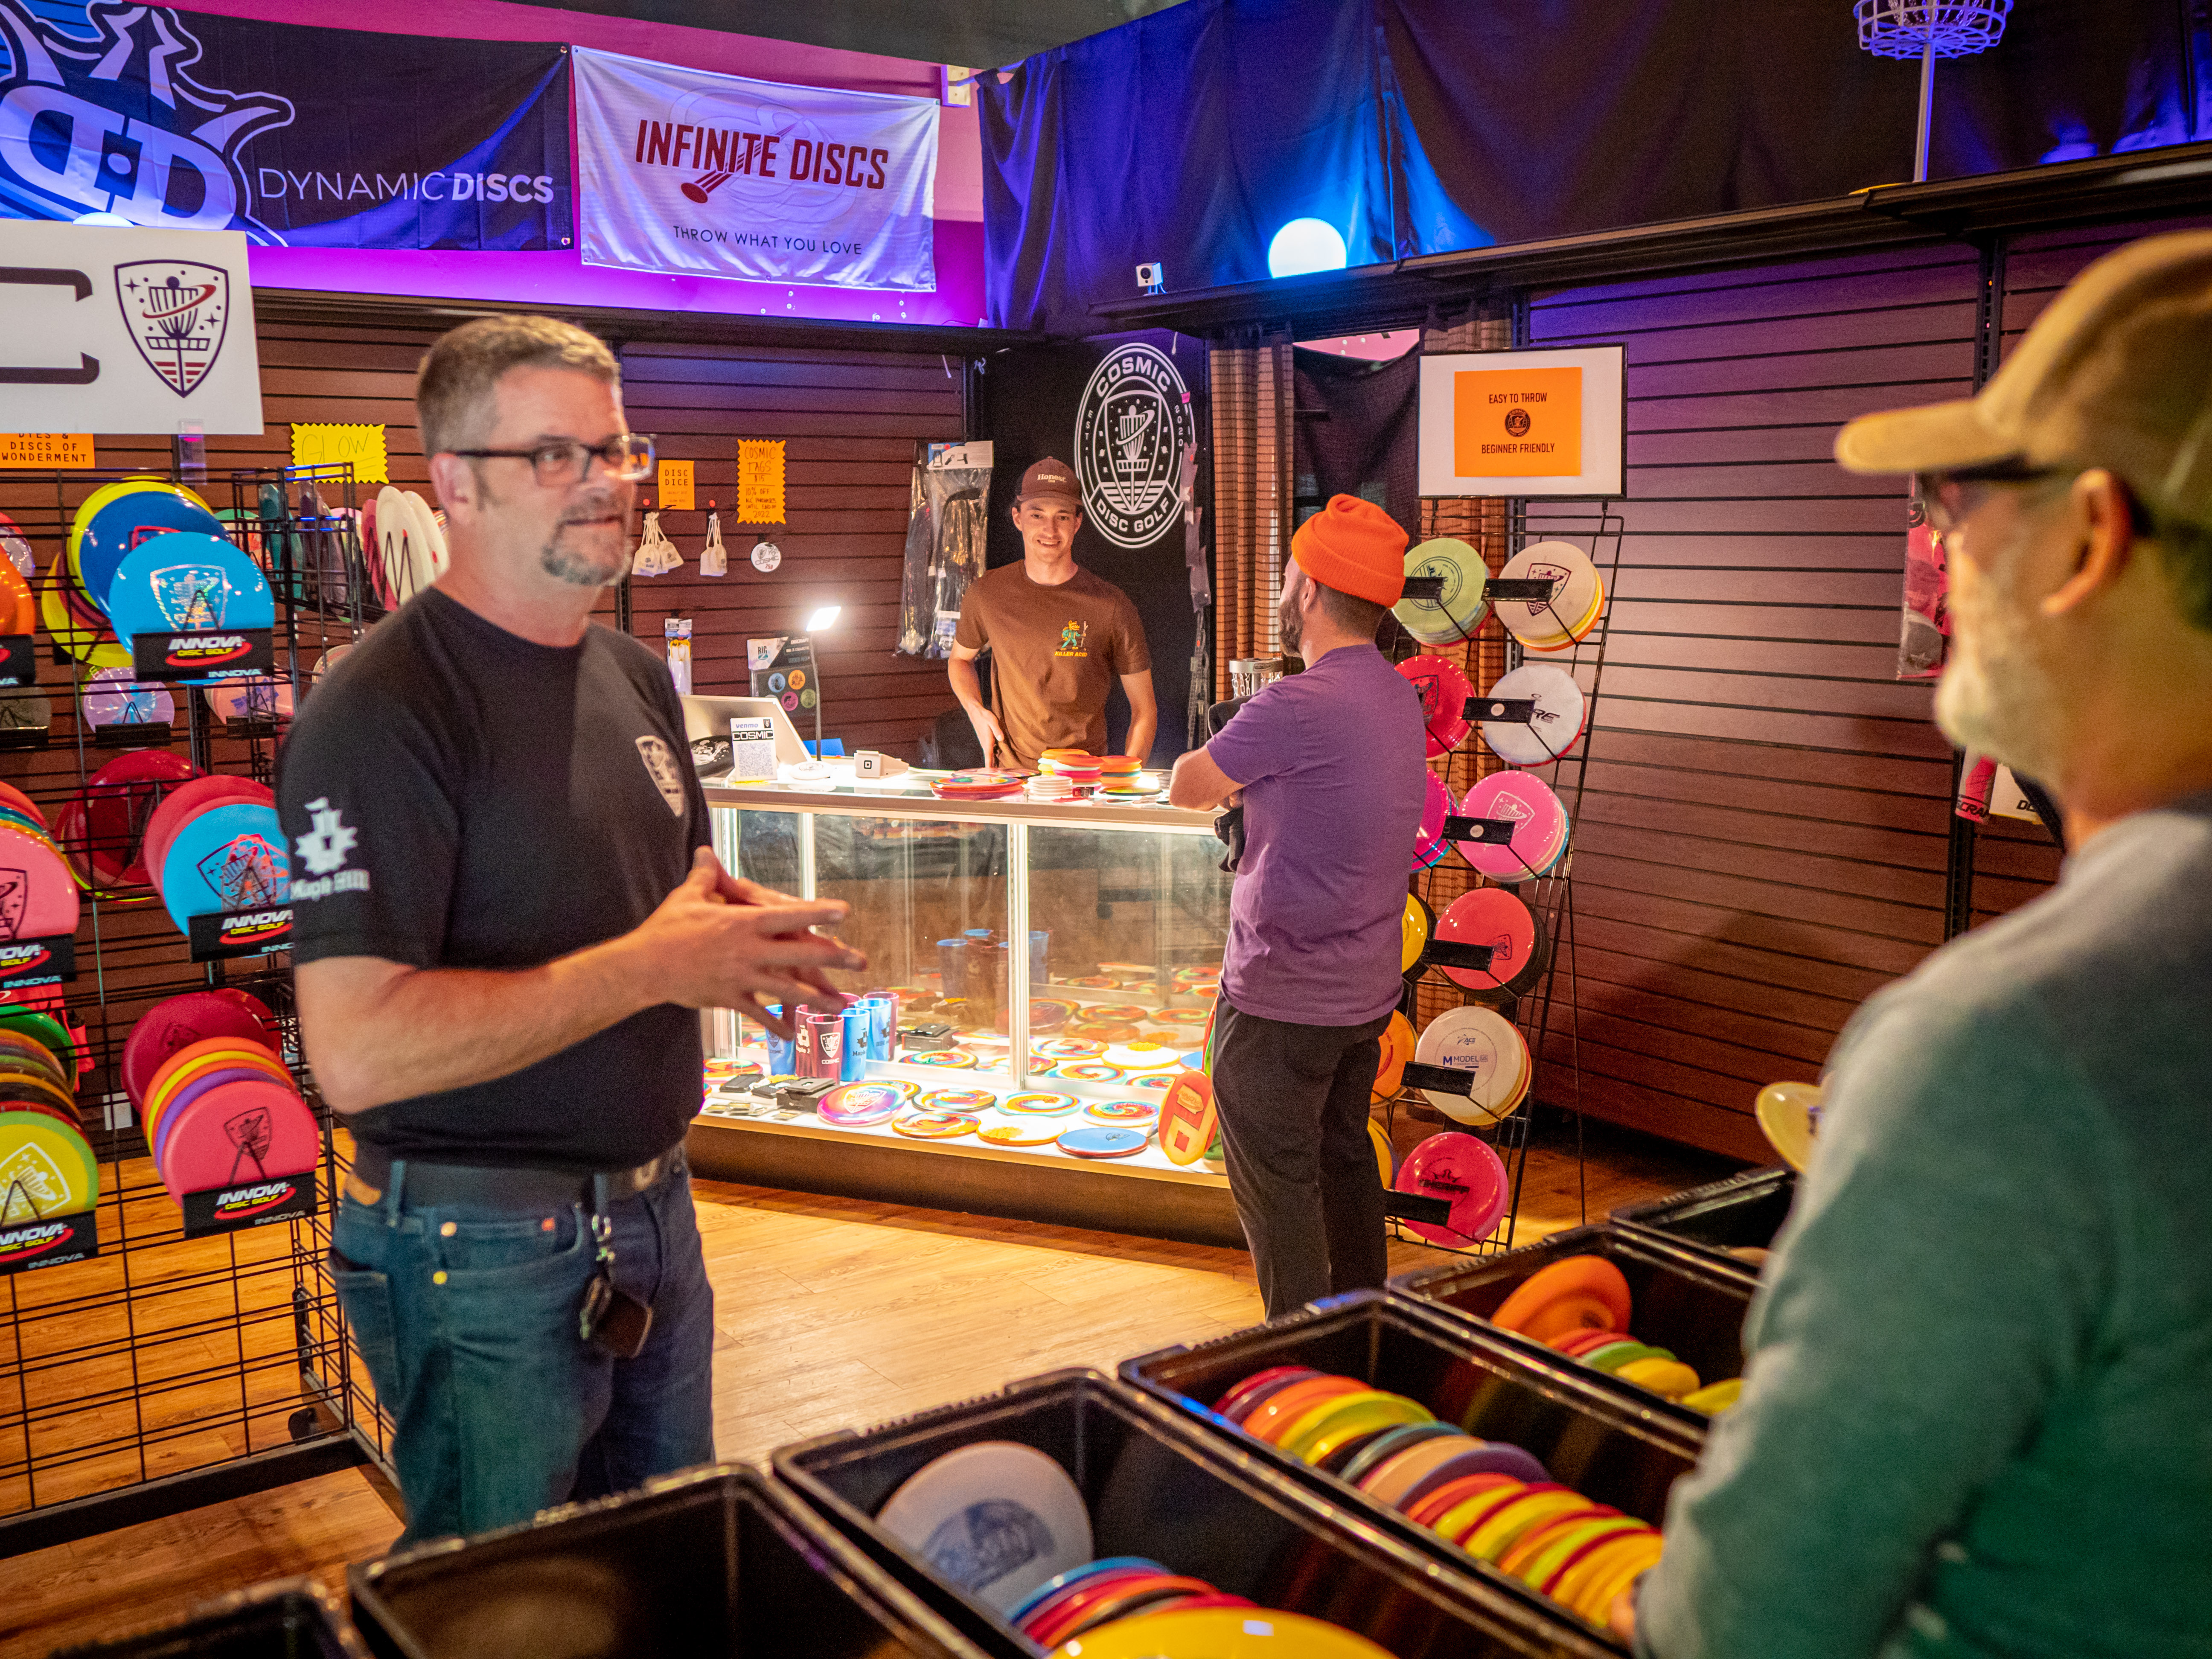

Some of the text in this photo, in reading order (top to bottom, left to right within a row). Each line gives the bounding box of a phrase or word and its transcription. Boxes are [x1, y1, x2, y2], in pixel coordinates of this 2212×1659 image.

[636, 119, 888, 189] INFINITE DISCS
[259, 168, 553, 203] DYNAMIC DISCS
[673, 225, 862, 255] THROW WHAT YOU LOVE
[1096, 356, 1170, 397] COSMIC
[1489, 392, 1548, 404] EASY TO THROW
[1174, 405, 1184, 447] 2020
[10, 441, 77, 451] DISCS OF
[1481, 442, 1555, 454] BEGINNER FRIENDLY
[2, 452, 87, 462] WONDERMENT
[744, 446, 776, 460] COSMIC
[747, 460, 771, 473] TAGS
[754, 474, 765, 483] $15
[745, 486, 757, 496] 10%
[752, 510, 770, 518] 2022
[1096, 497, 1169, 533] DISC GOLF
[168, 636, 243, 650] INNOVA
[208, 669, 262, 678] INNOVA
[732, 731, 774, 741] COSMIC
[221, 909, 294, 930] INNOVA
[230, 922, 285, 934] DISC GOLF
[3, 975, 62, 988] INNOVA
[216, 1182, 287, 1206] INNOVA
[225, 1194, 279, 1210] DISC GOLF
[254, 1210, 306, 1225] INNOVA
[24, 1236, 55, 1247] GOLF
[28, 1252, 85, 1269] INNOVA
